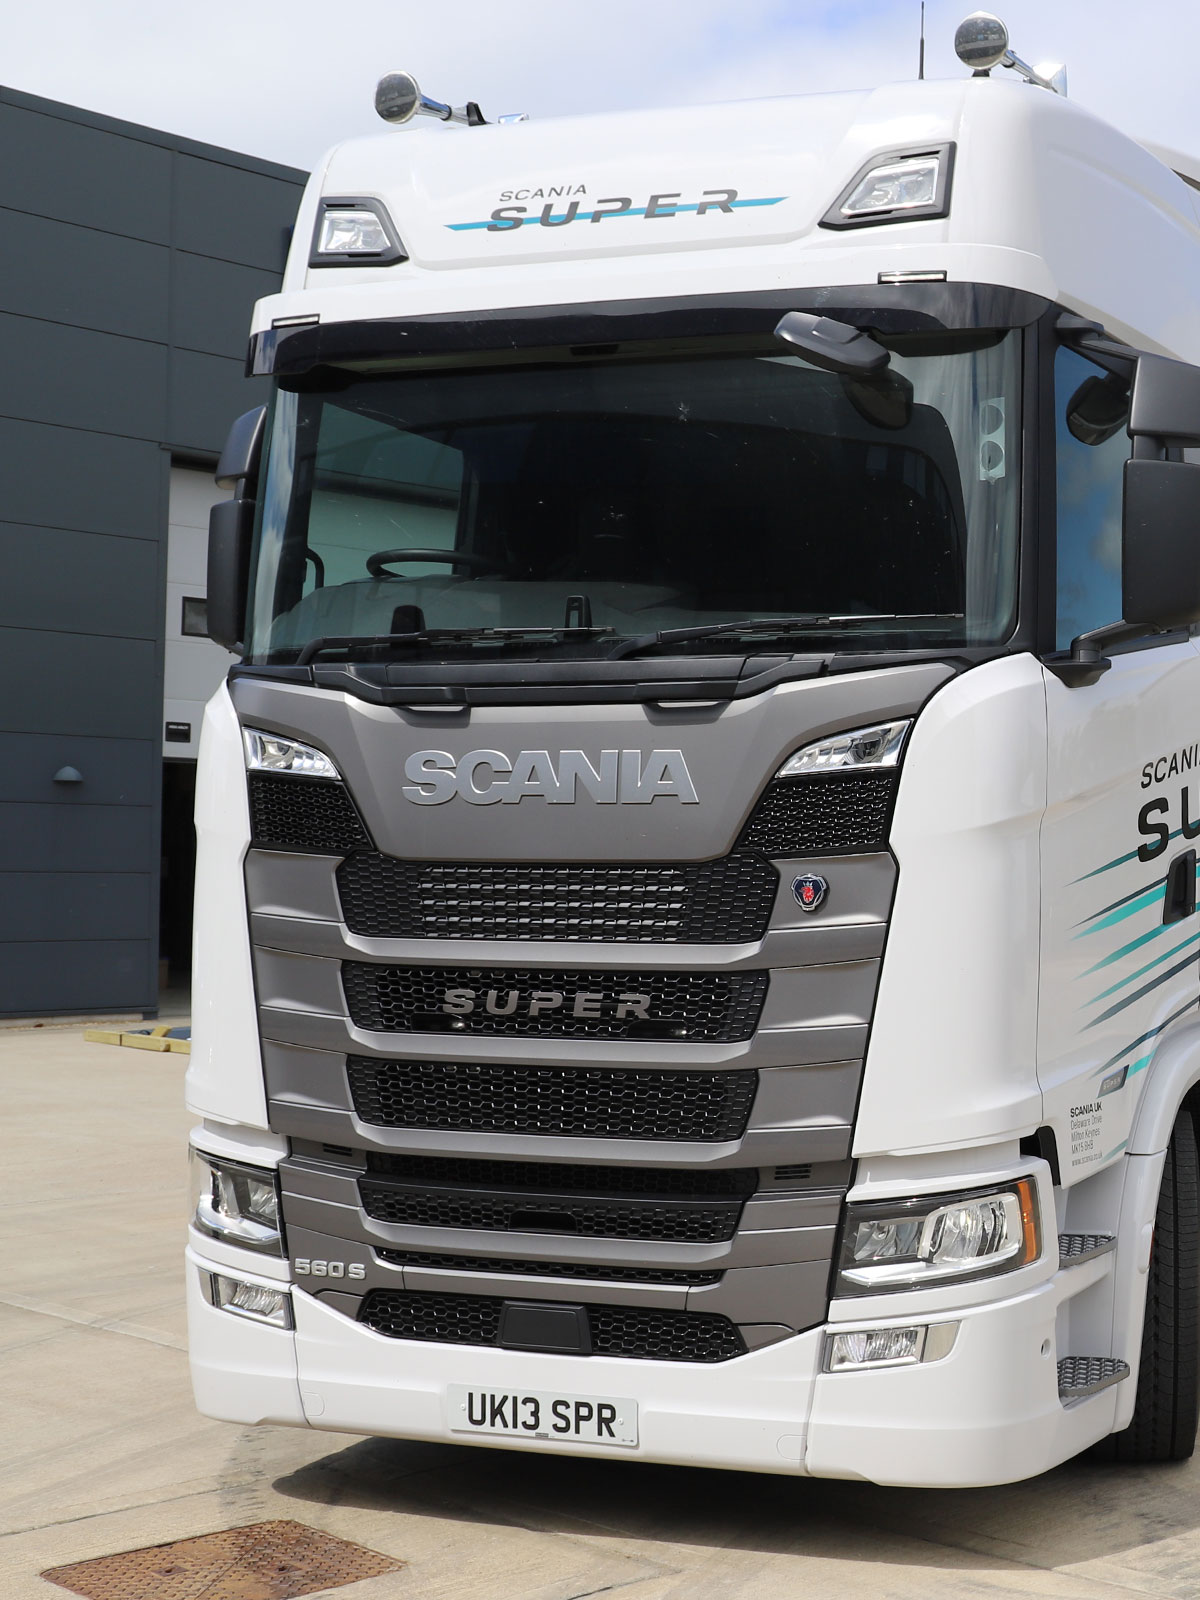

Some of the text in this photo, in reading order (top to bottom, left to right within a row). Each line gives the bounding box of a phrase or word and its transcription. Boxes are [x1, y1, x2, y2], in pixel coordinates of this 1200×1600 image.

[498, 184, 587, 202] SCANIA
[487, 188, 739, 232] SUPER
[402, 749, 699, 805] SCANIA
[443, 988, 651, 1019] SUPER
[1070, 1102, 1102, 1118] SCANIA UK
[1070, 1115, 1102, 1130] Delaware Drive
[1071, 1127, 1100, 1142] Milton Keynes
[294, 1258, 366, 1280] 560 S
[467, 1391, 617, 1438] UK13 SPR
